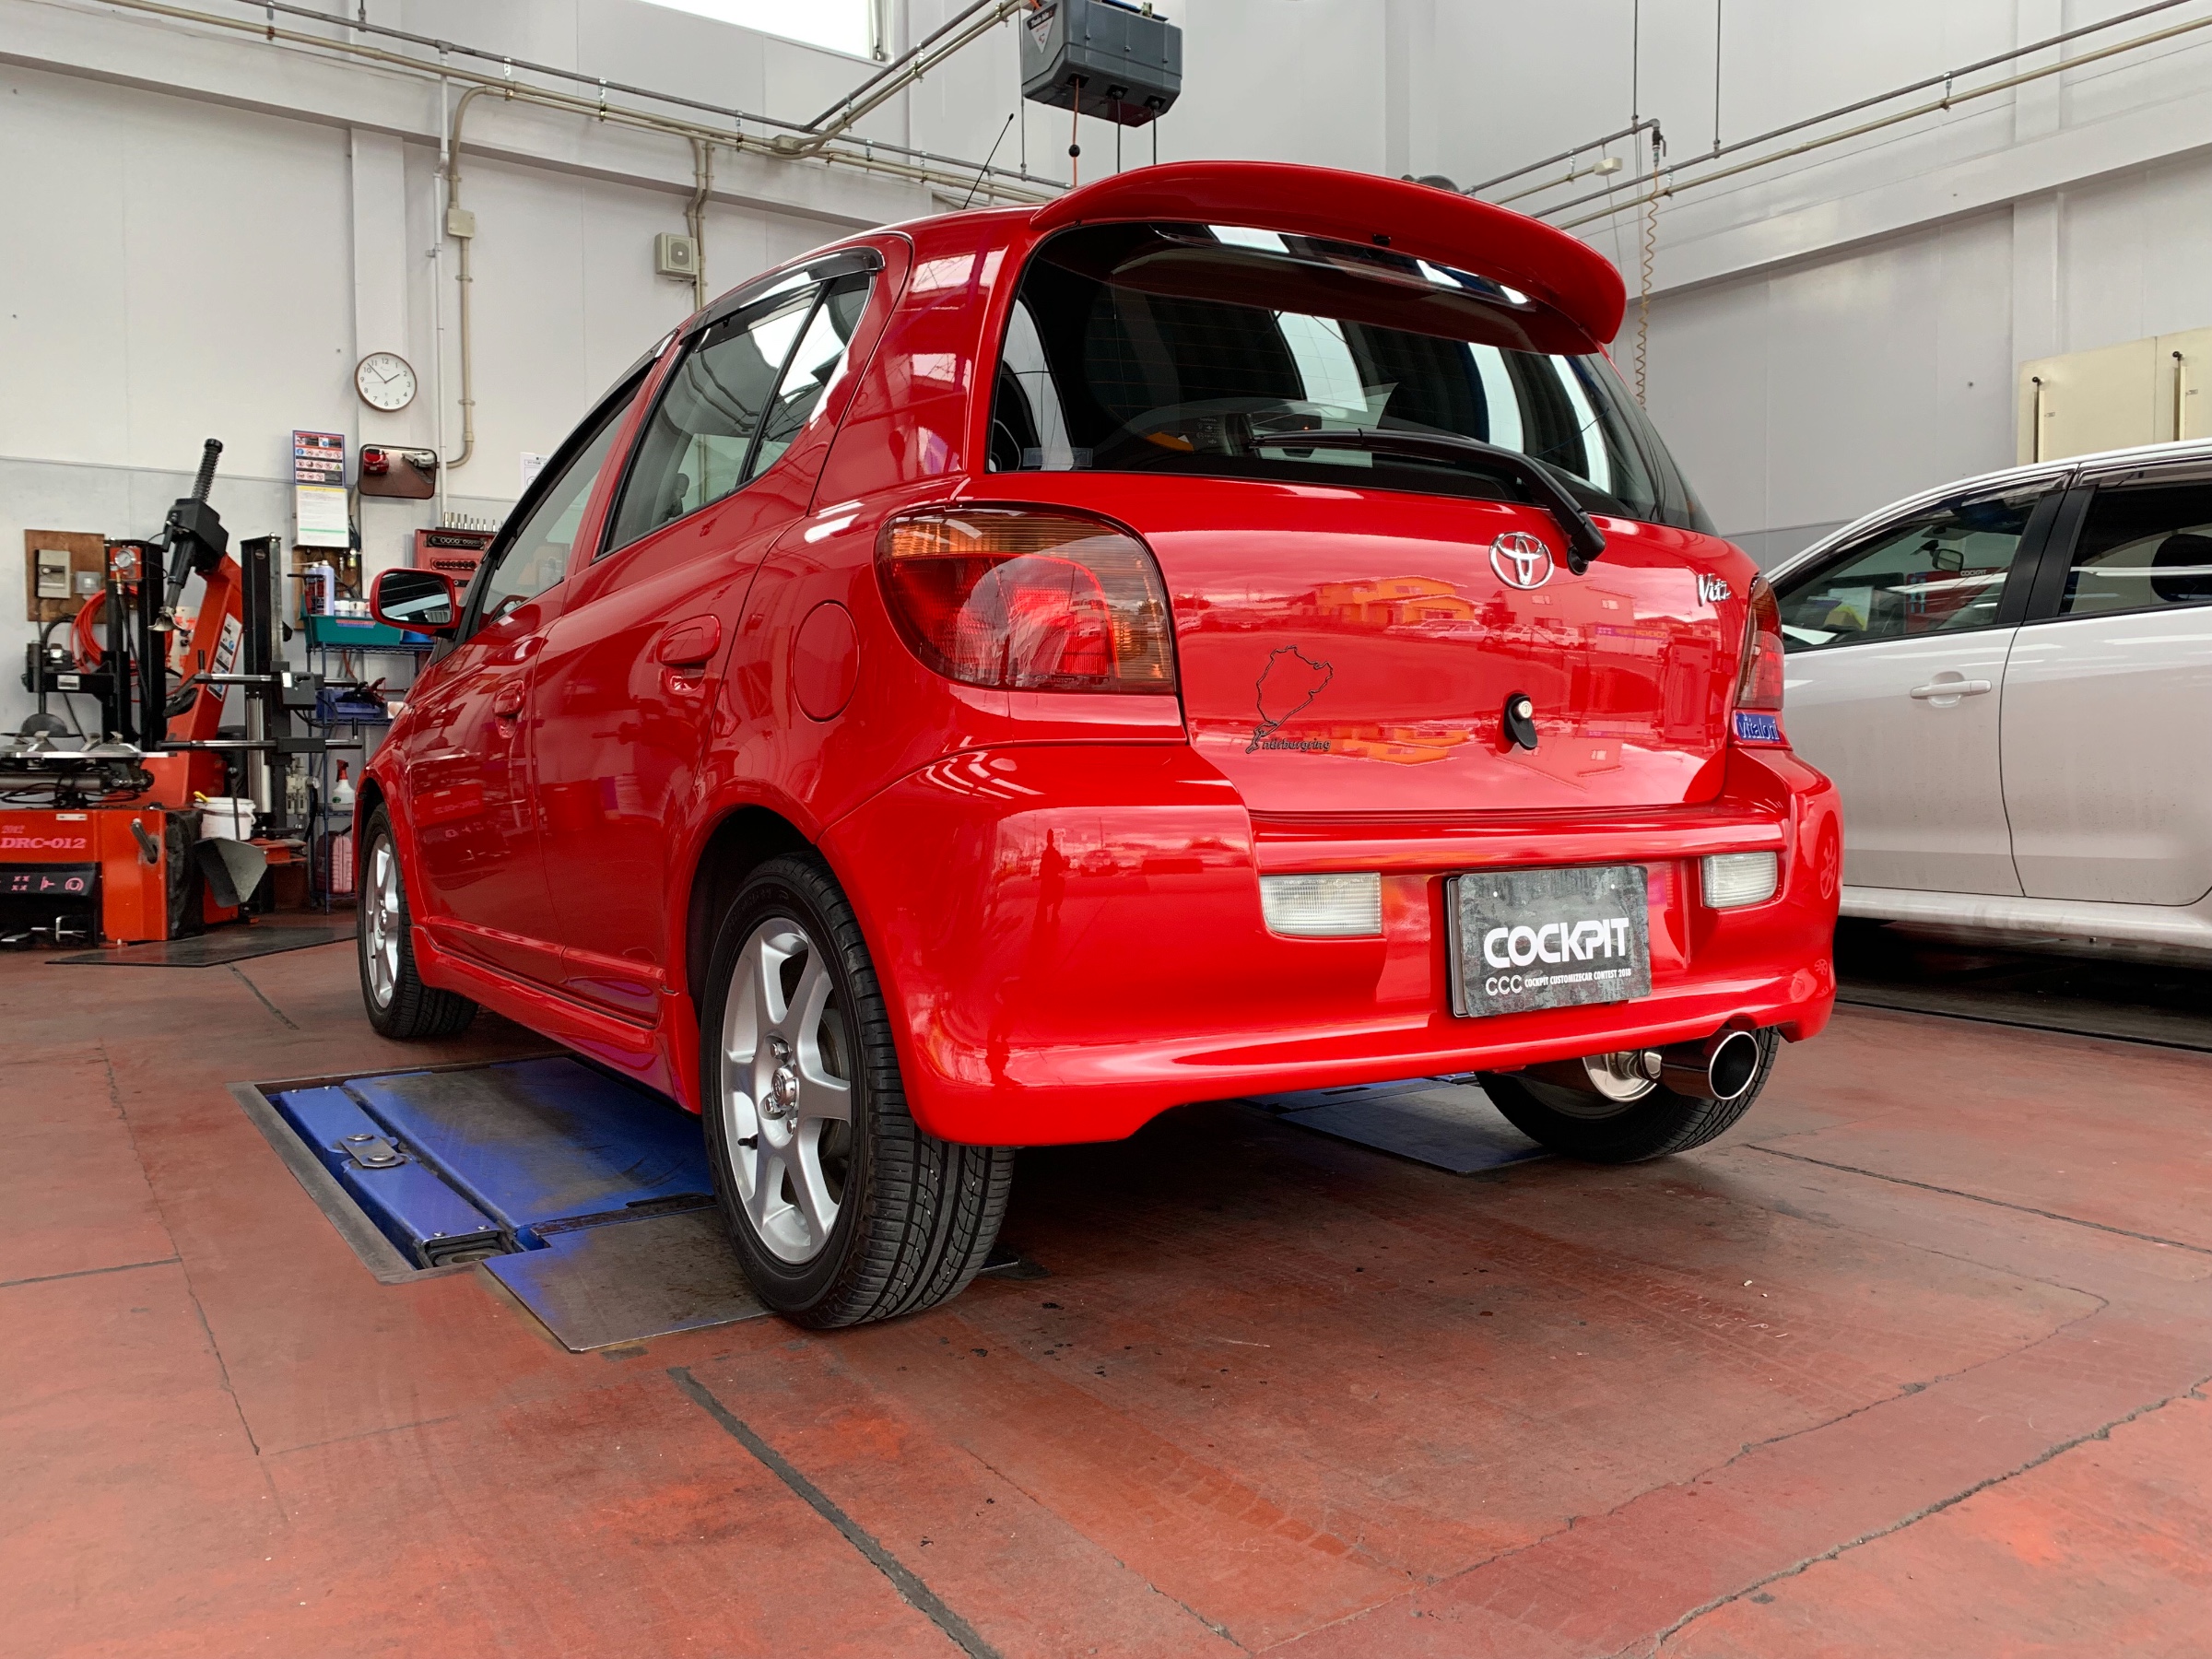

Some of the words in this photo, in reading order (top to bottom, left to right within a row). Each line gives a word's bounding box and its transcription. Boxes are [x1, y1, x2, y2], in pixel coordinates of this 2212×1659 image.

[0, 837, 87, 849] DRC-012
[1483, 918, 1629, 968] COCKPIT
[1485, 974, 1522, 996] CCC
[1524, 976, 1548, 988] COCKPIT
[1550, 971, 1593, 985] CUSTOMIZECAR
[1594, 969, 1618, 980] CONTEST
